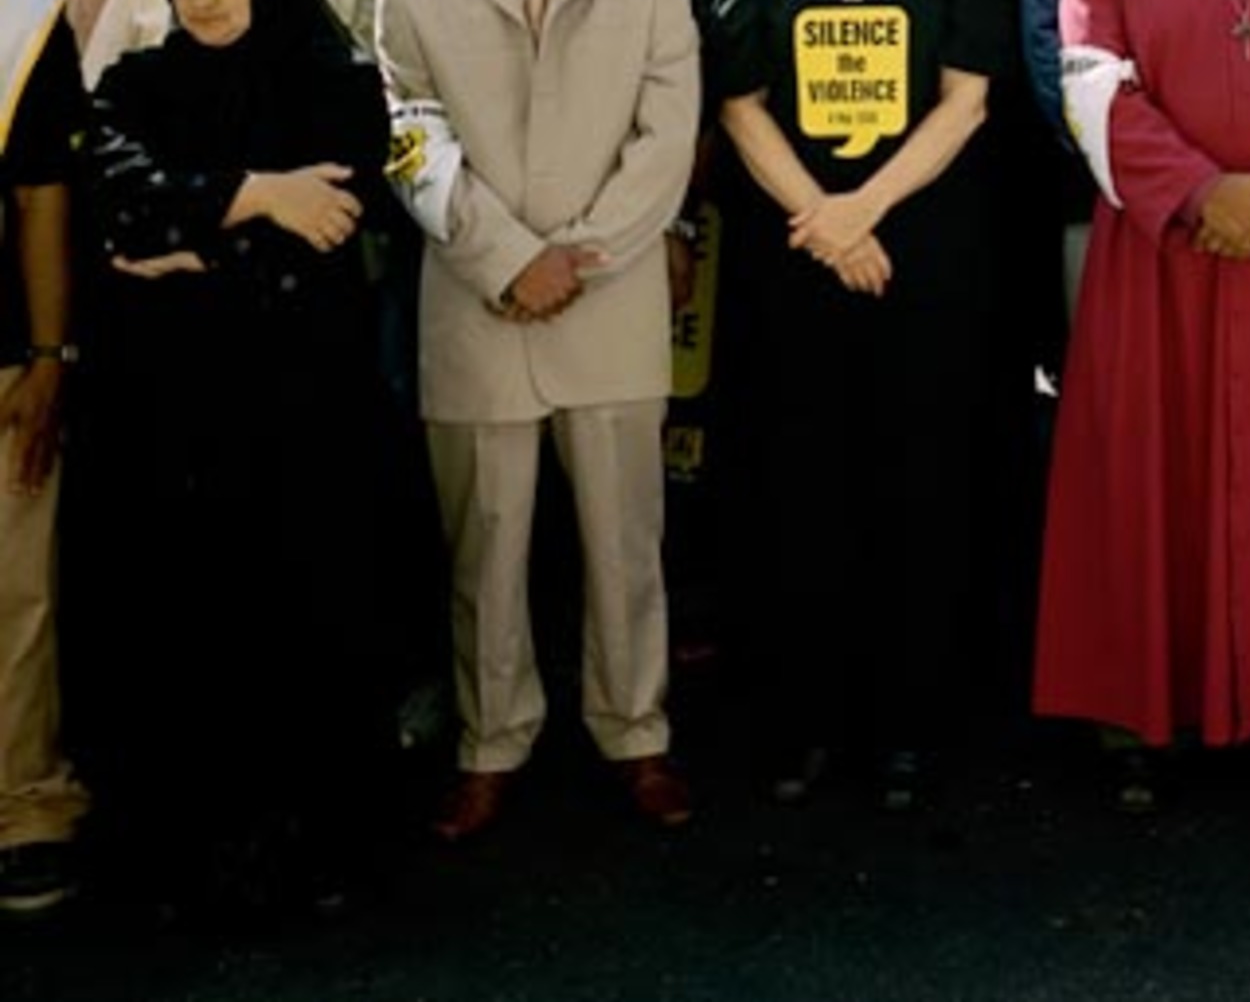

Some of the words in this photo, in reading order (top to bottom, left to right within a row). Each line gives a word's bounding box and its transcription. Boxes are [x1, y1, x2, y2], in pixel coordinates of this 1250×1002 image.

[804, 19, 899, 48] SILENCE
[837, 53, 866, 73] the
[808, 79, 897, 103] VIOLENCE
